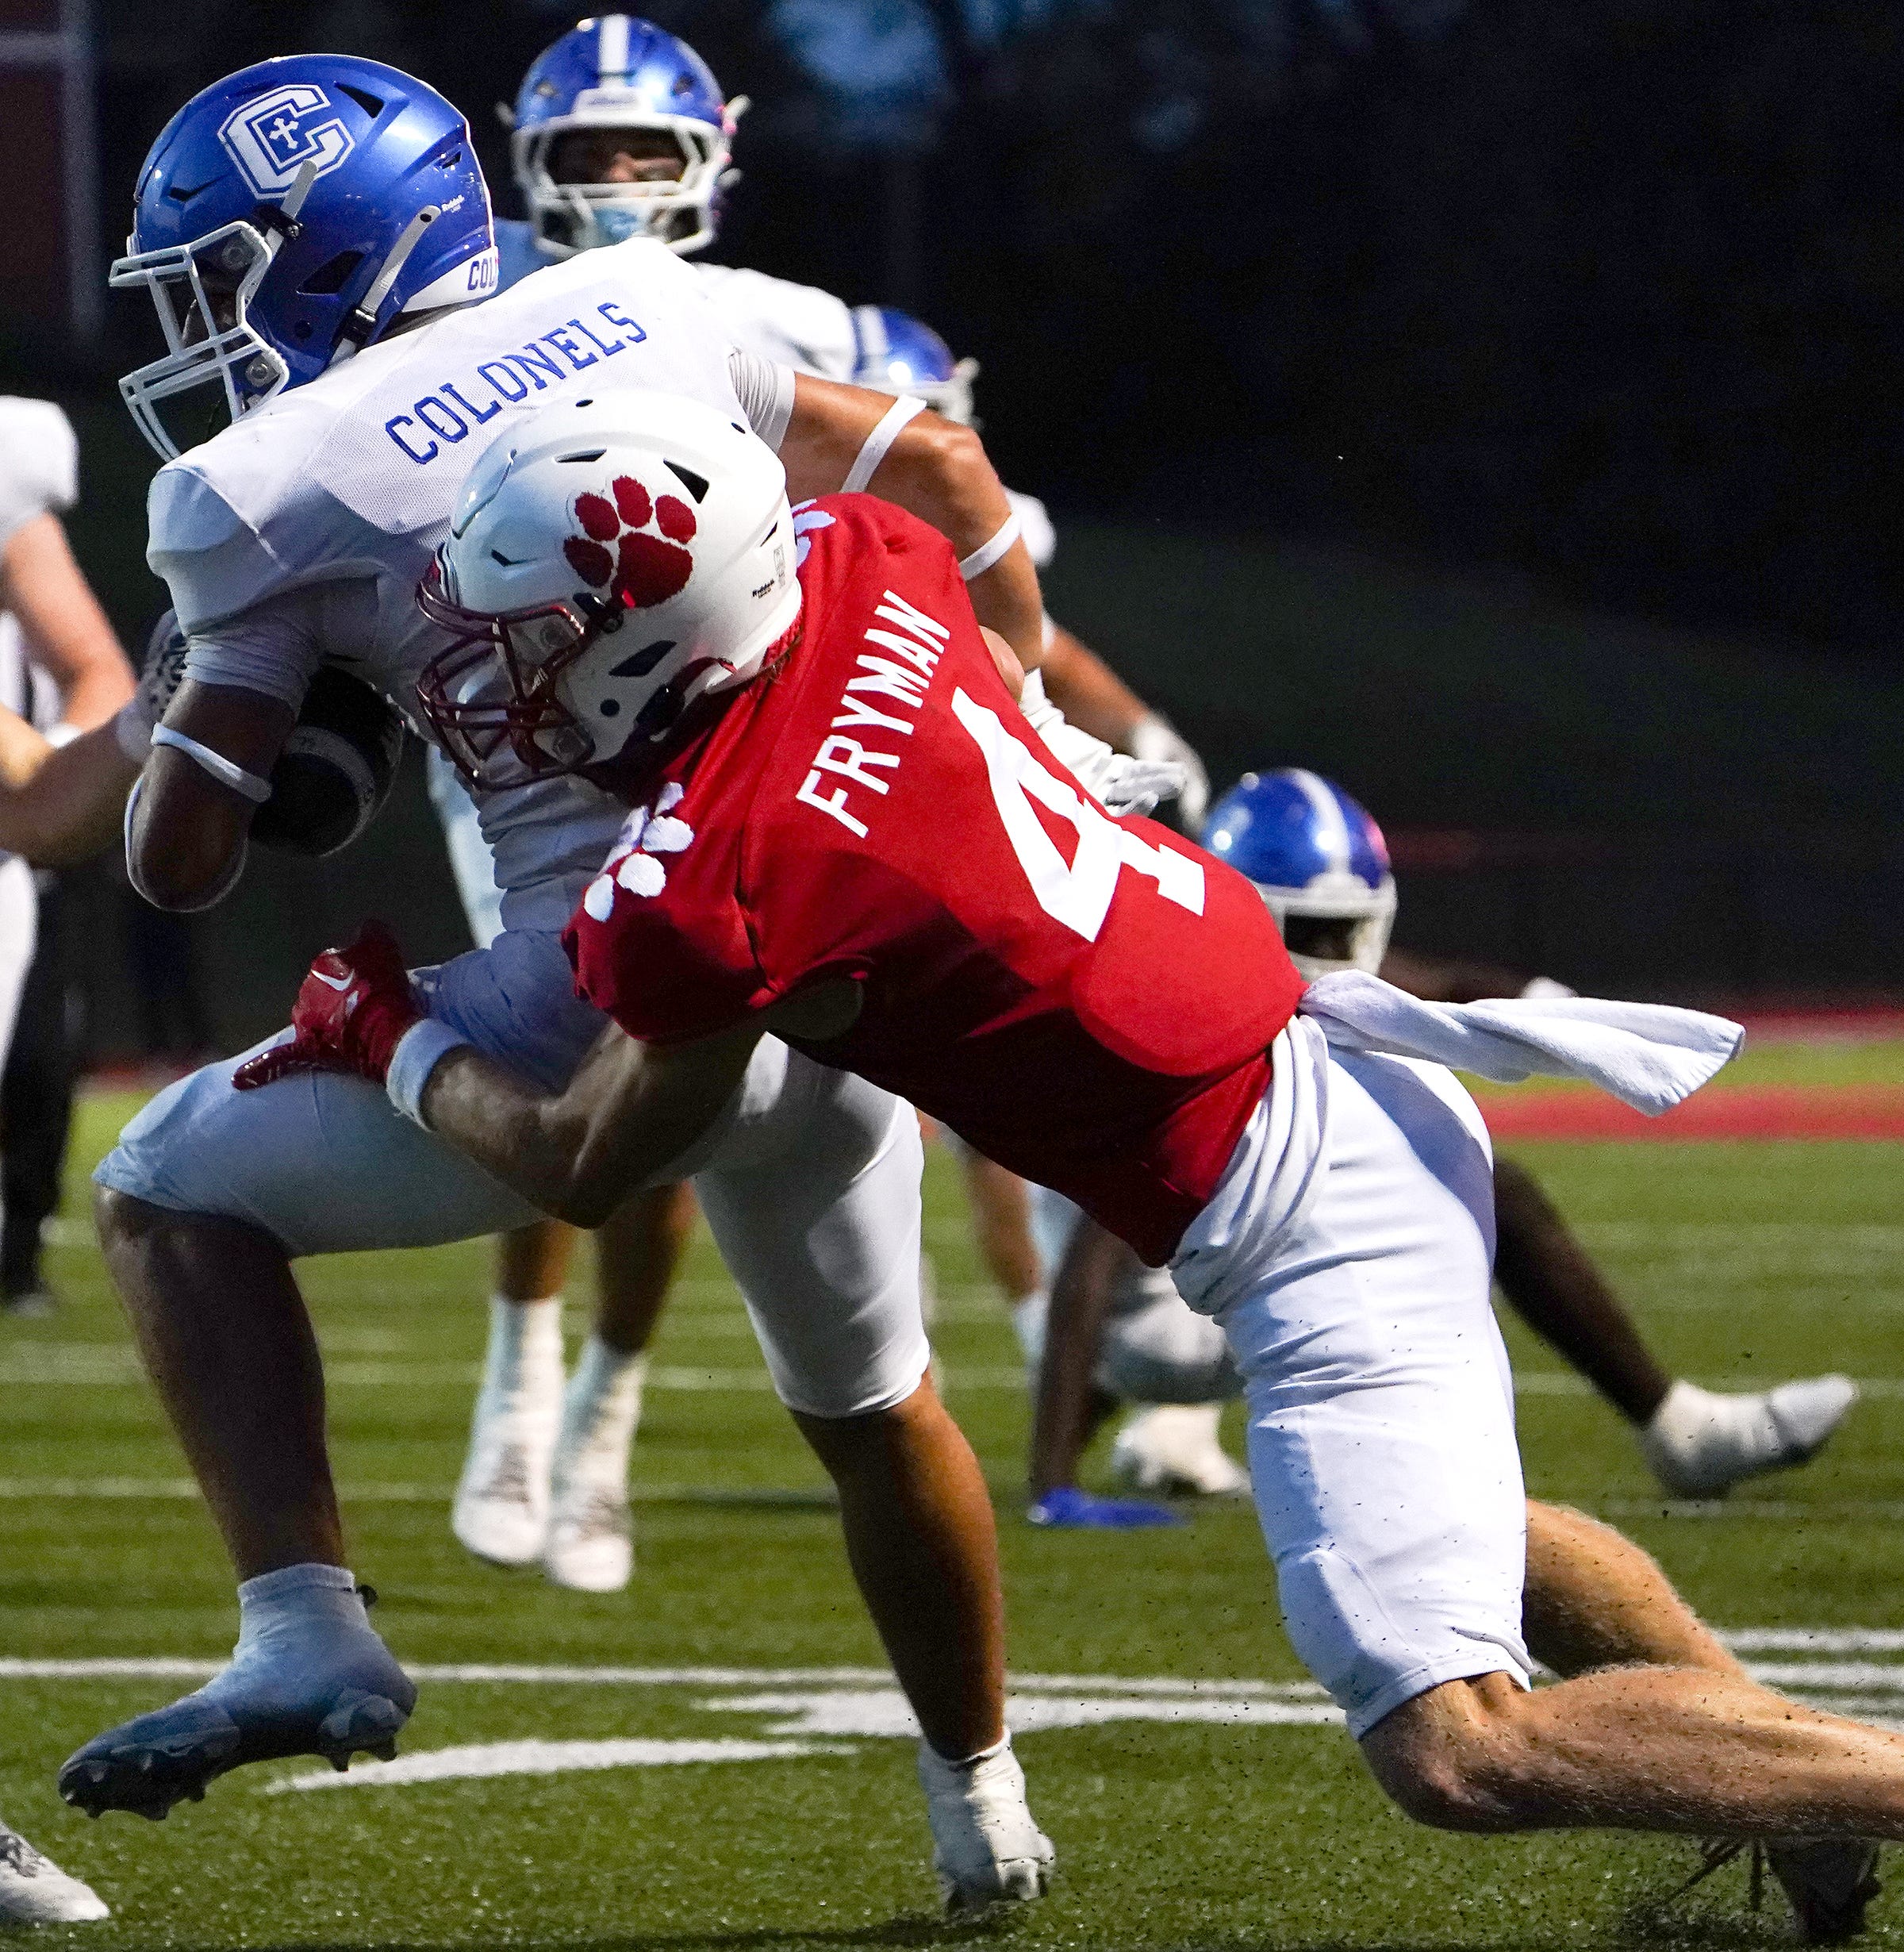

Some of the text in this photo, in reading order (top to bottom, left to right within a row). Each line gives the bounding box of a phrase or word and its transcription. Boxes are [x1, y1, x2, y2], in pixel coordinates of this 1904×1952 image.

[217, 84, 355, 198] C
[386, 302, 647, 464] COLONELS
[796, 590, 950, 839] FRYMAN
[951, 686, 1205, 943] 4
